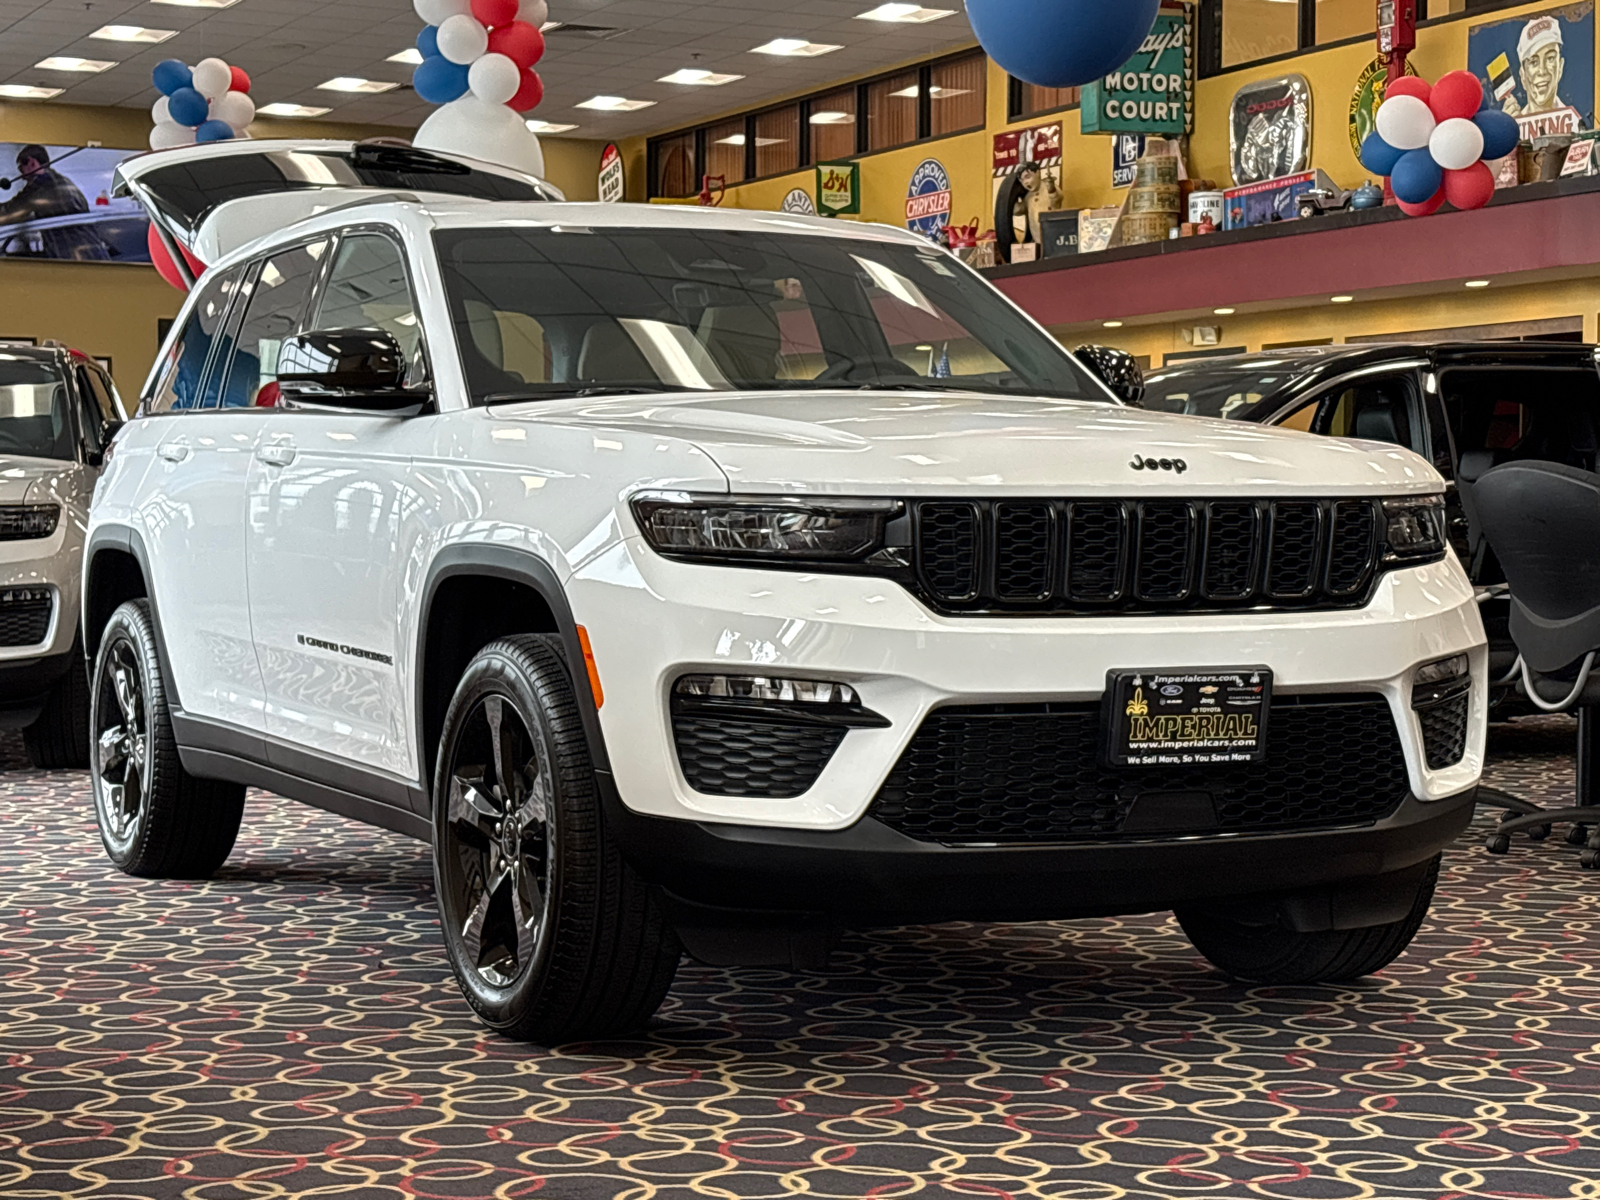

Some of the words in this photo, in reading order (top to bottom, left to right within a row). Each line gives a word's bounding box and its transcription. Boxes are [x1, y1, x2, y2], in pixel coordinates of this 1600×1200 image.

[1136, 24, 1184, 69] ay's
[1105, 72, 1181, 92] MOTOR
[1350, 66, 1374, 114] NATIONAL
[1106, 100, 1180, 120] COURT
[911, 163, 947, 196] APPROVED
[782, 192, 814, 216] LANTIC
[906, 193, 951, 218] CHRYSLER
[1128, 454, 1187, 474] Jeep
[1154, 674, 1240, 684] Imperialcars.com
[1200, 697, 1216, 705] Jeep
[1129, 714, 1258, 741] IMPERIAL
[1129, 739, 1256, 749] www.imperialcars.com
[1127, 756, 1140, 764] We
[1142, 755, 1157, 764] Sell
[1158, 755, 1181, 764] More,
[1182, 755, 1193, 763] So
[1194, 754, 1209, 762] You
[1210, 754, 1230, 762] Save
[1231, 753, 1251, 761] More
